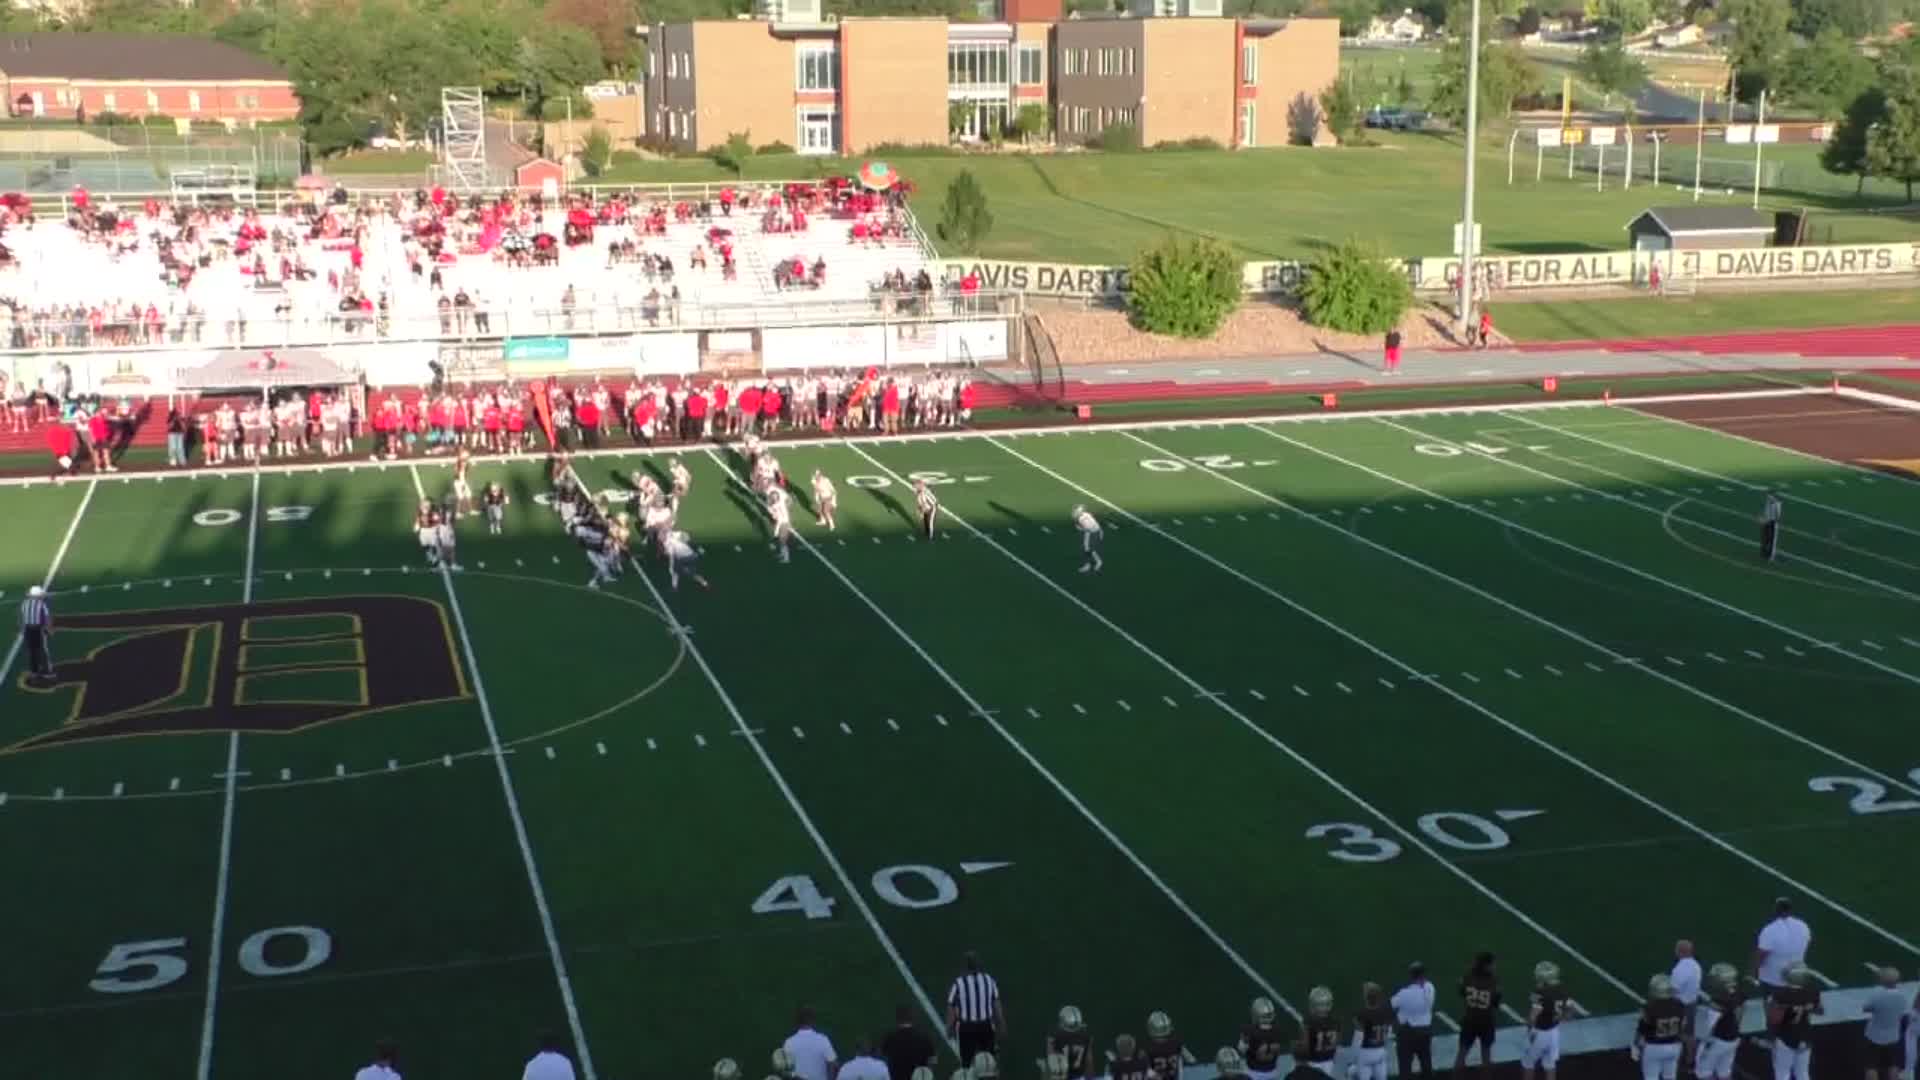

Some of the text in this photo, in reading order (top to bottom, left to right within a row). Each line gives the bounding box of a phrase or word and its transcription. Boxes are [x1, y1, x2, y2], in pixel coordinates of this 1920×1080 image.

[1507, 259, 1563, 283] FOR
[1570, 256, 1621, 280] ALL
[1717, 248, 1893, 275] DAVIS DARTS
[1305, 812, 1510, 862] 30
[752, 864, 959, 919] 40
[88, 925, 332, 993] 50
